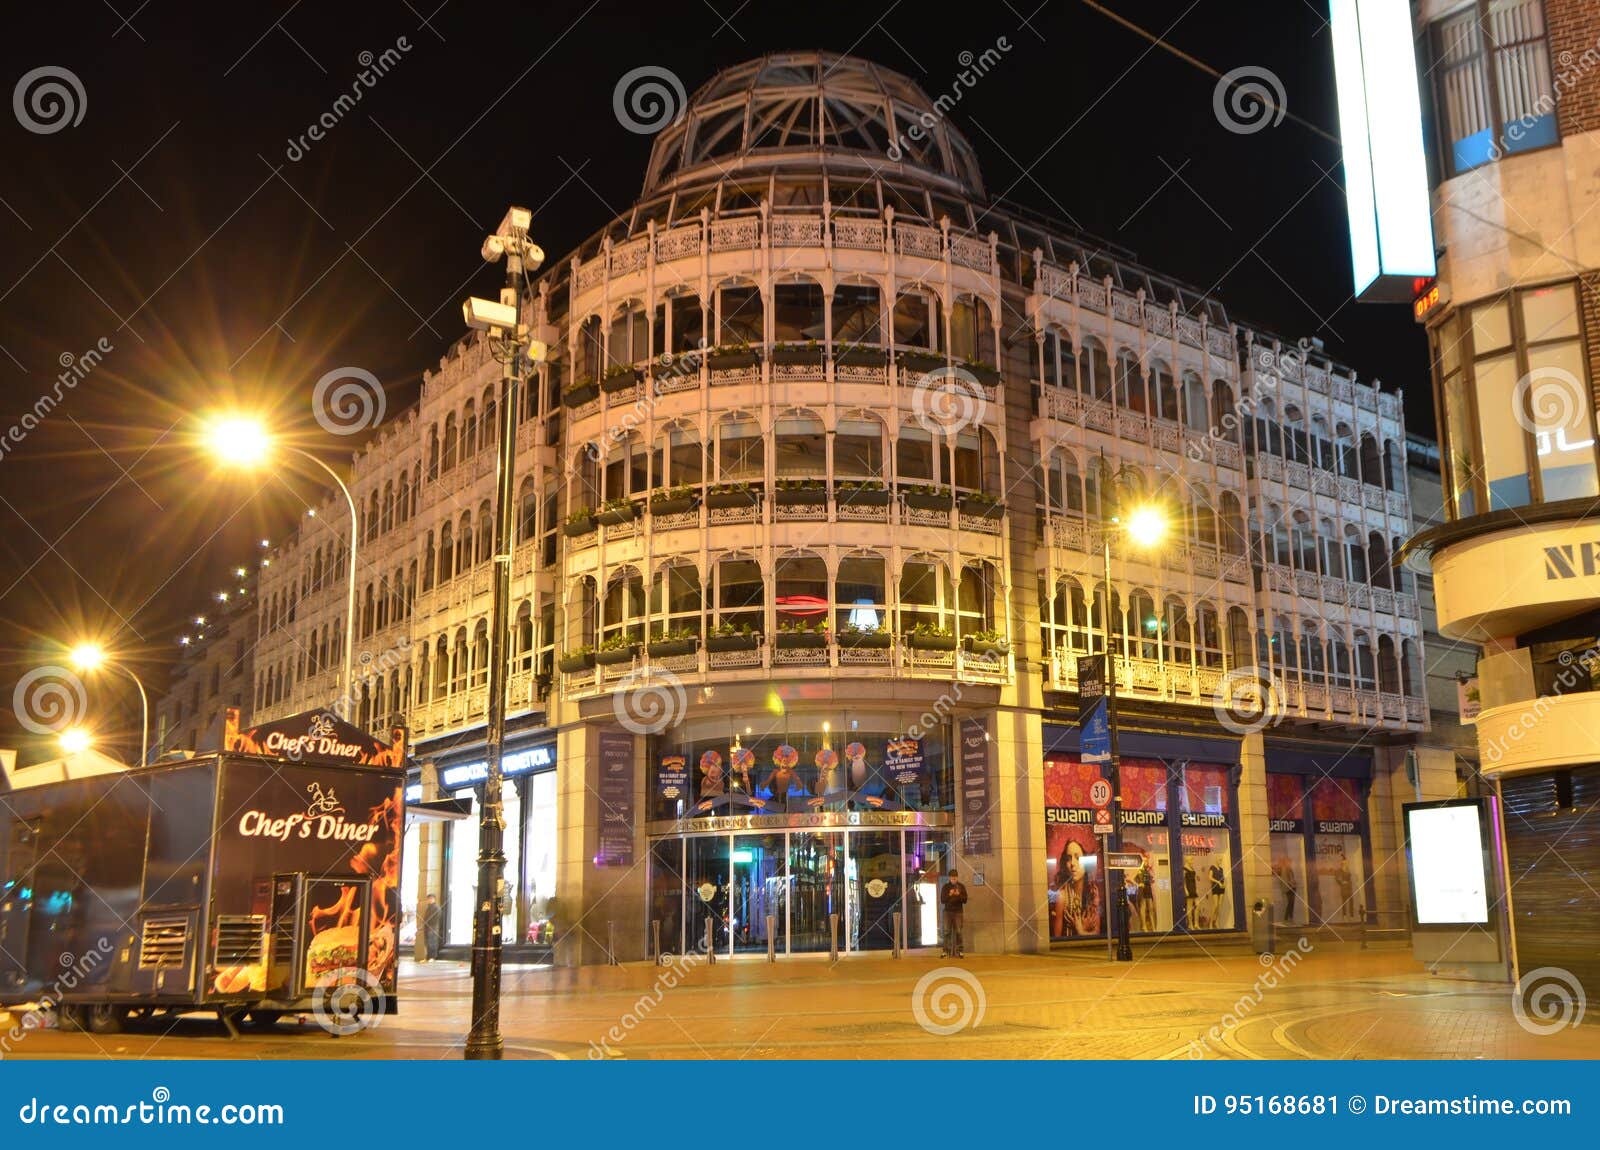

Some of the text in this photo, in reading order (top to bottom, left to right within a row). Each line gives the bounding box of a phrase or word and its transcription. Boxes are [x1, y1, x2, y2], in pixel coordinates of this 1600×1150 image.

[266, 732, 361, 758] Chef's Diner
[1094, 785, 1106, 799] 30
[1047, 808, 1093, 823] swam
[239, 811, 379, 841] Chef's Diner
